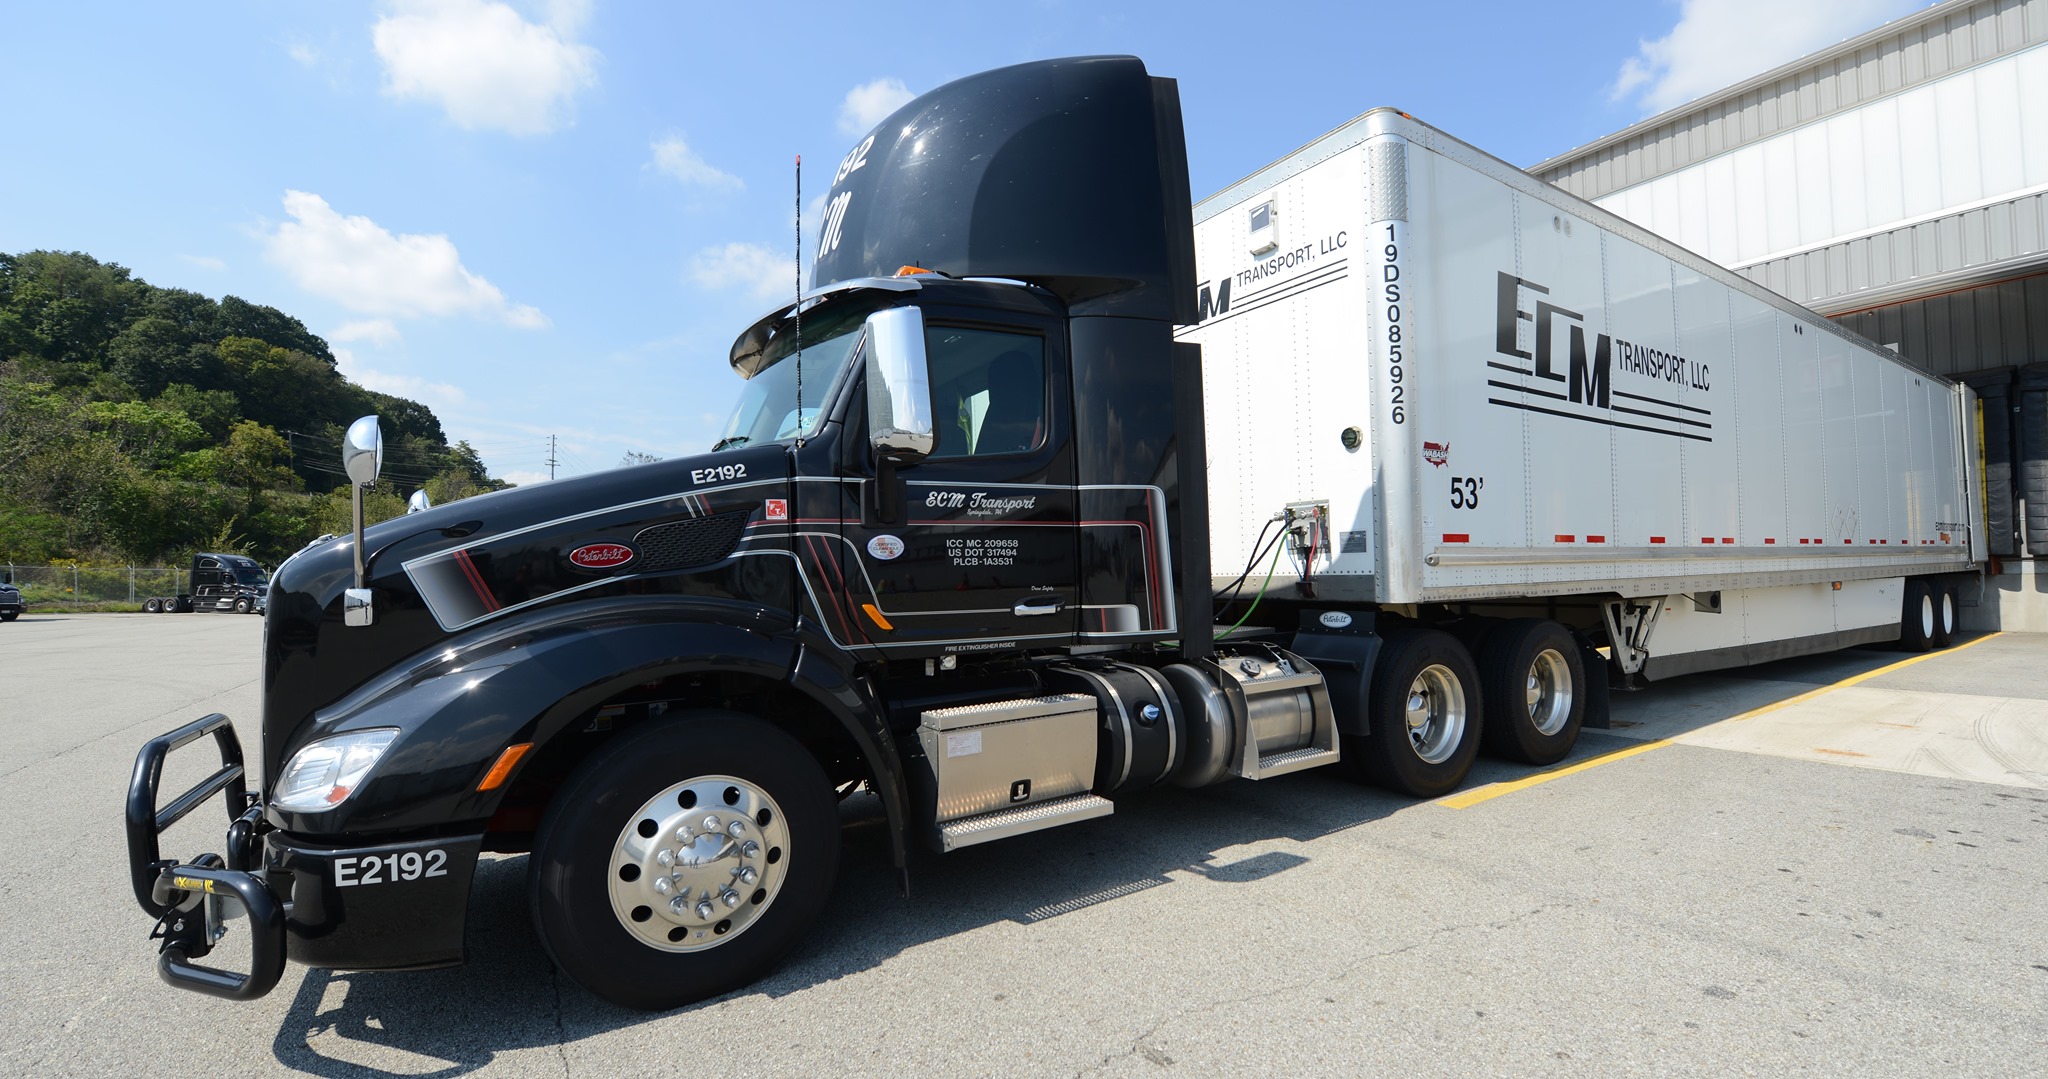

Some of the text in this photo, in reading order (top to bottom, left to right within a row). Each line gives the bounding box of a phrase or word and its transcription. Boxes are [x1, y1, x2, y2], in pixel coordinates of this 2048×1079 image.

[1236, 243, 1316, 288] TRANSPORT,
[1320, 231, 1348, 256] LLC
[1384, 224, 1405, 424] 19DS085926
[1496, 270, 1711, 409] ECM TRANSPORT, LLC
[691, 463, 747, 485] E2192
[925, 491, 1037, 512] ECM Transport
[946, 539, 1019, 548] ICC MC 209658
[948, 548, 1017, 557] US DOT 317494
[578, 548, 628, 563] Peterbilt
[953, 557, 1013, 566] PLCB-1A3531
[958, 642, 998, 651] EXTINGUISHER
[998, 641, 1017, 649] INSIDE
[334, 849, 448, 888] E2192
